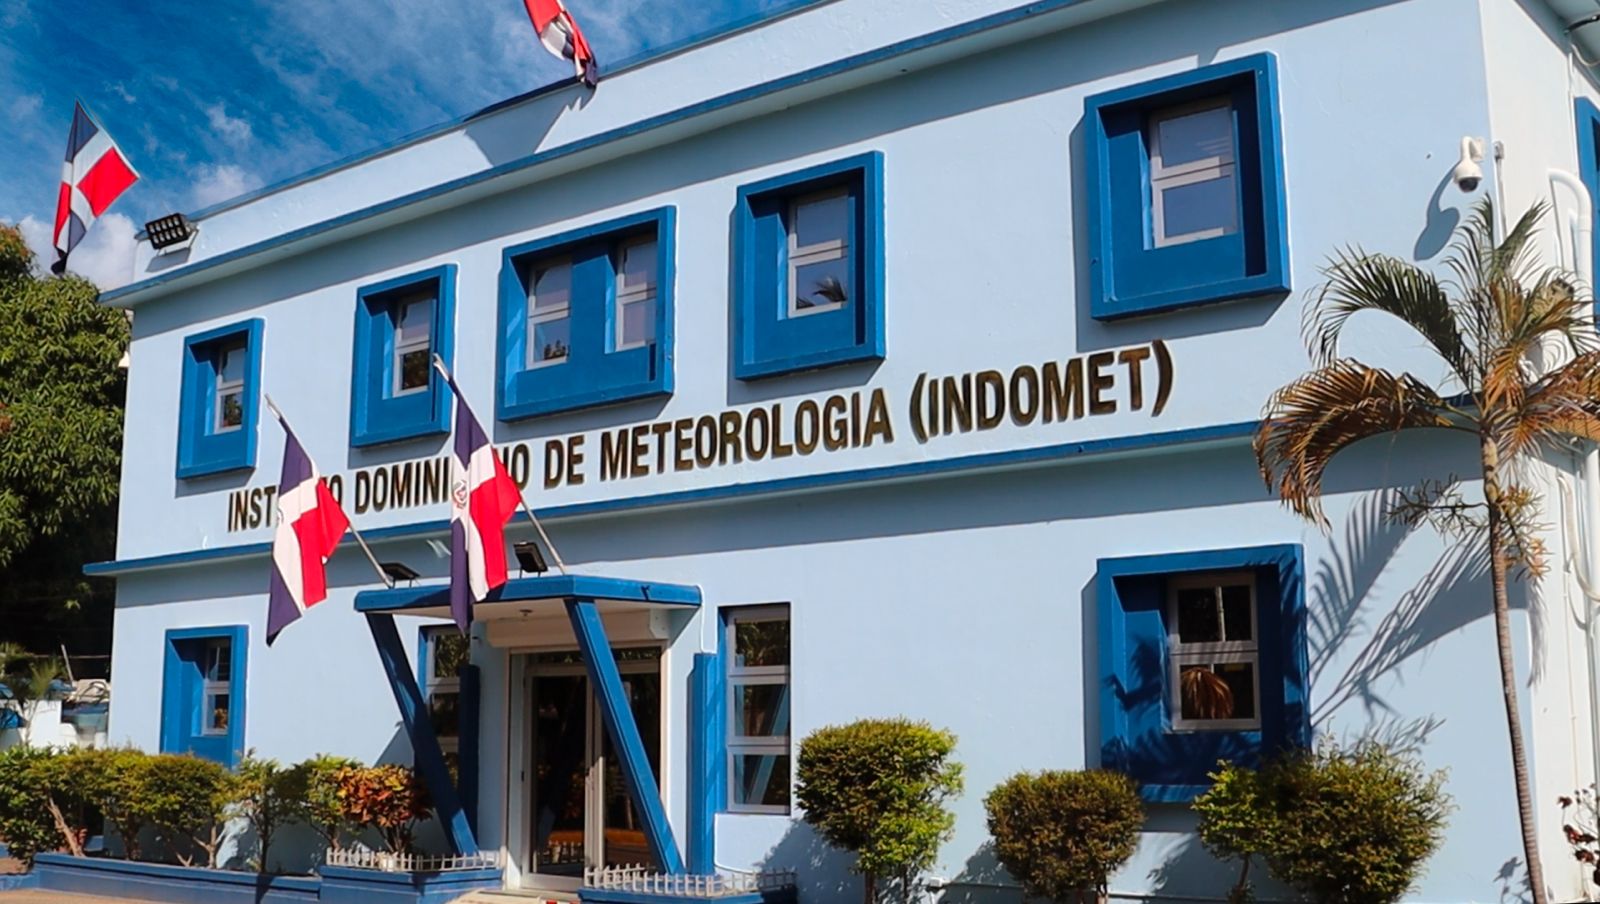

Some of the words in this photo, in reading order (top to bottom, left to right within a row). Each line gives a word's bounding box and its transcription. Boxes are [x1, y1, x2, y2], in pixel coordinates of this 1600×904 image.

[227, 475, 342, 532] INSTO
[355, 444, 529, 514] DOMINIO
[544, 435, 585, 490] DE
[600, 387, 894, 481] METEOROLOGIA
[909, 339, 1174, 444] (INDOMET)
